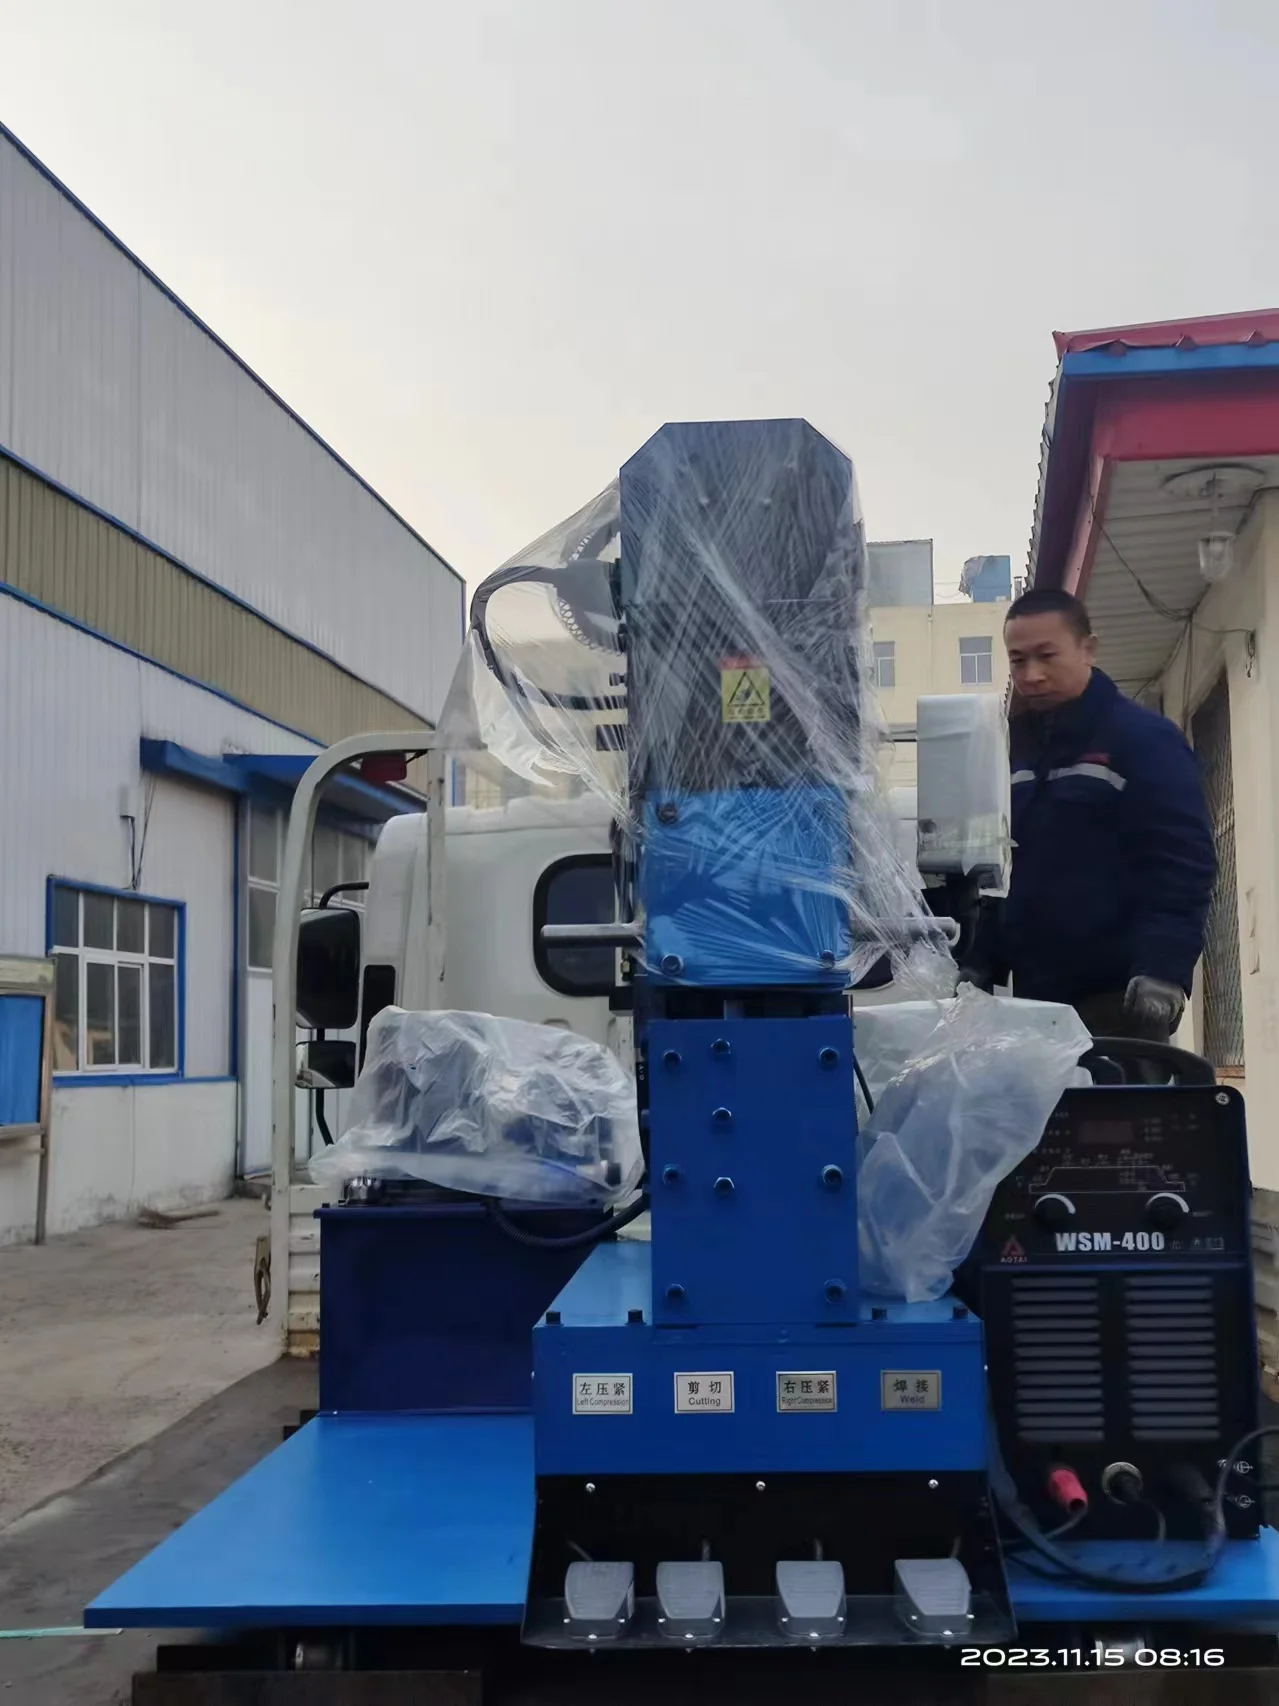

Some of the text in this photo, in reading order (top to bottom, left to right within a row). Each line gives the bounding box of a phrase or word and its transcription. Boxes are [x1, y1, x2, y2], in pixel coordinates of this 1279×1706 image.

[1055, 1232, 1165, 1252] WSM-400
[579, 1381, 626, 1396] 左压紧
[688, 1380, 722, 1395] 剪切
[783, 1380, 829, 1394] 右压紧
[892, 1378, 929, 1393] 焊接
[577, 1397, 629, 1407] Left Compression
[688, 1397, 721, 1407] Cutting
[899, 1395, 925, 1404] Weld
